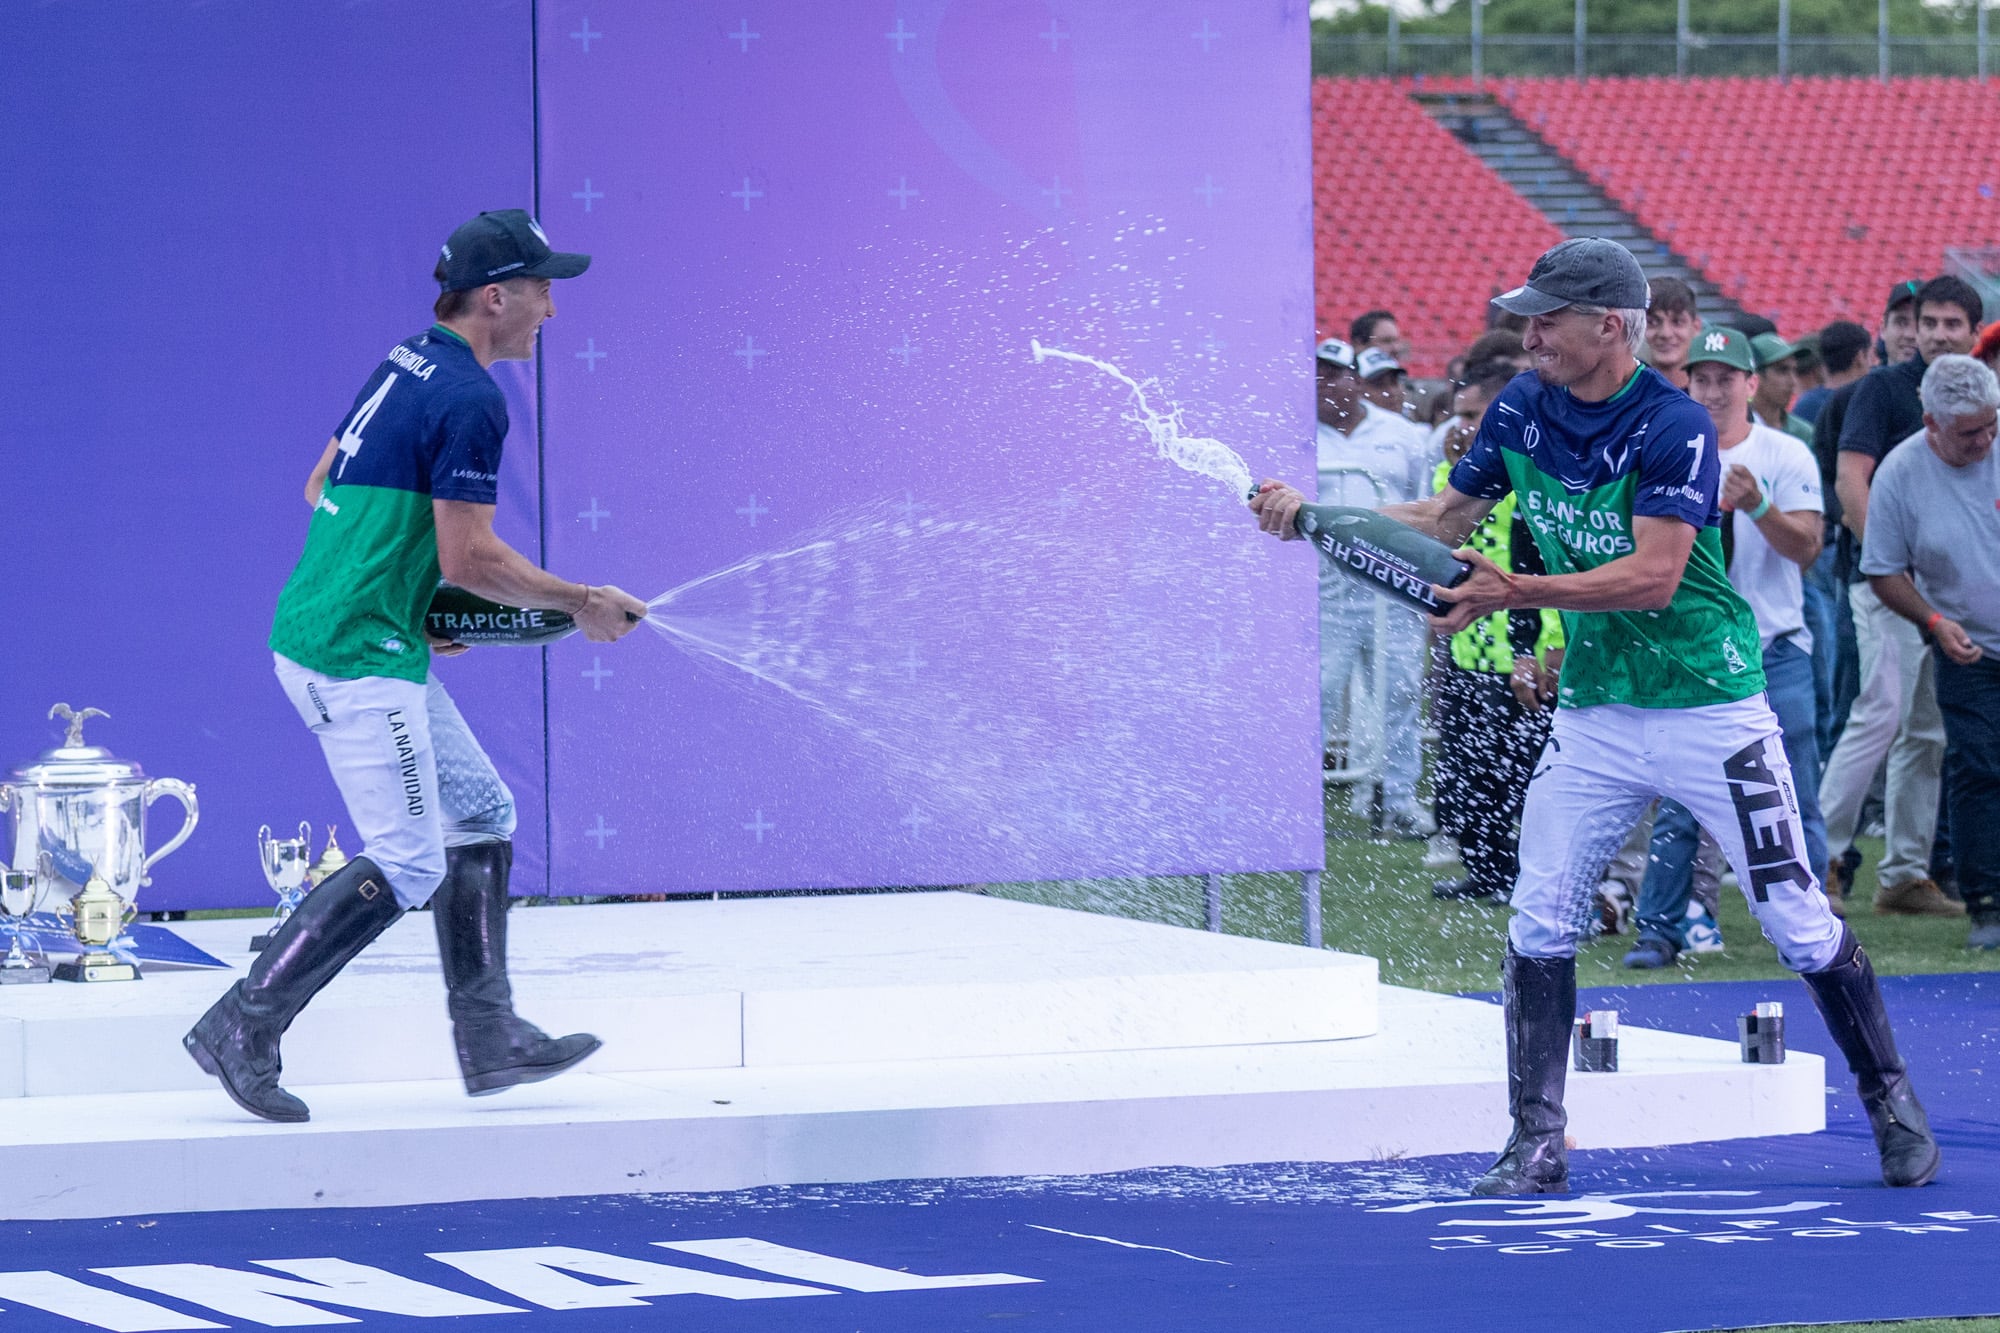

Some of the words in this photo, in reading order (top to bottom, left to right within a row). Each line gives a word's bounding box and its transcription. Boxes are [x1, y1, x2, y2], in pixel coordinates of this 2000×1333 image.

[337, 371, 399, 480] 4
[1687, 433, 1705, 482] 1
[1352, 535, 1420, 573] ARGENTINA
[1533, 514, 1632, 555] SEGUROS
[1321, 533, 1438, 608] TRAPICHE
[429, 611, 545, 629] TRAPICHE
[460, 632, 521, 640] ARGENTINA
[387, 710, 405, 733] LA
[394, 733, 424, 816] NATIVIDAD
[1723, 738, 1813, 903] JETA
[1429, 1210, 1998, 1244] TRIPLE
[1497, 1224, 1968, 1254] CORON
[0, 1237, 1046, 1332] INAL
